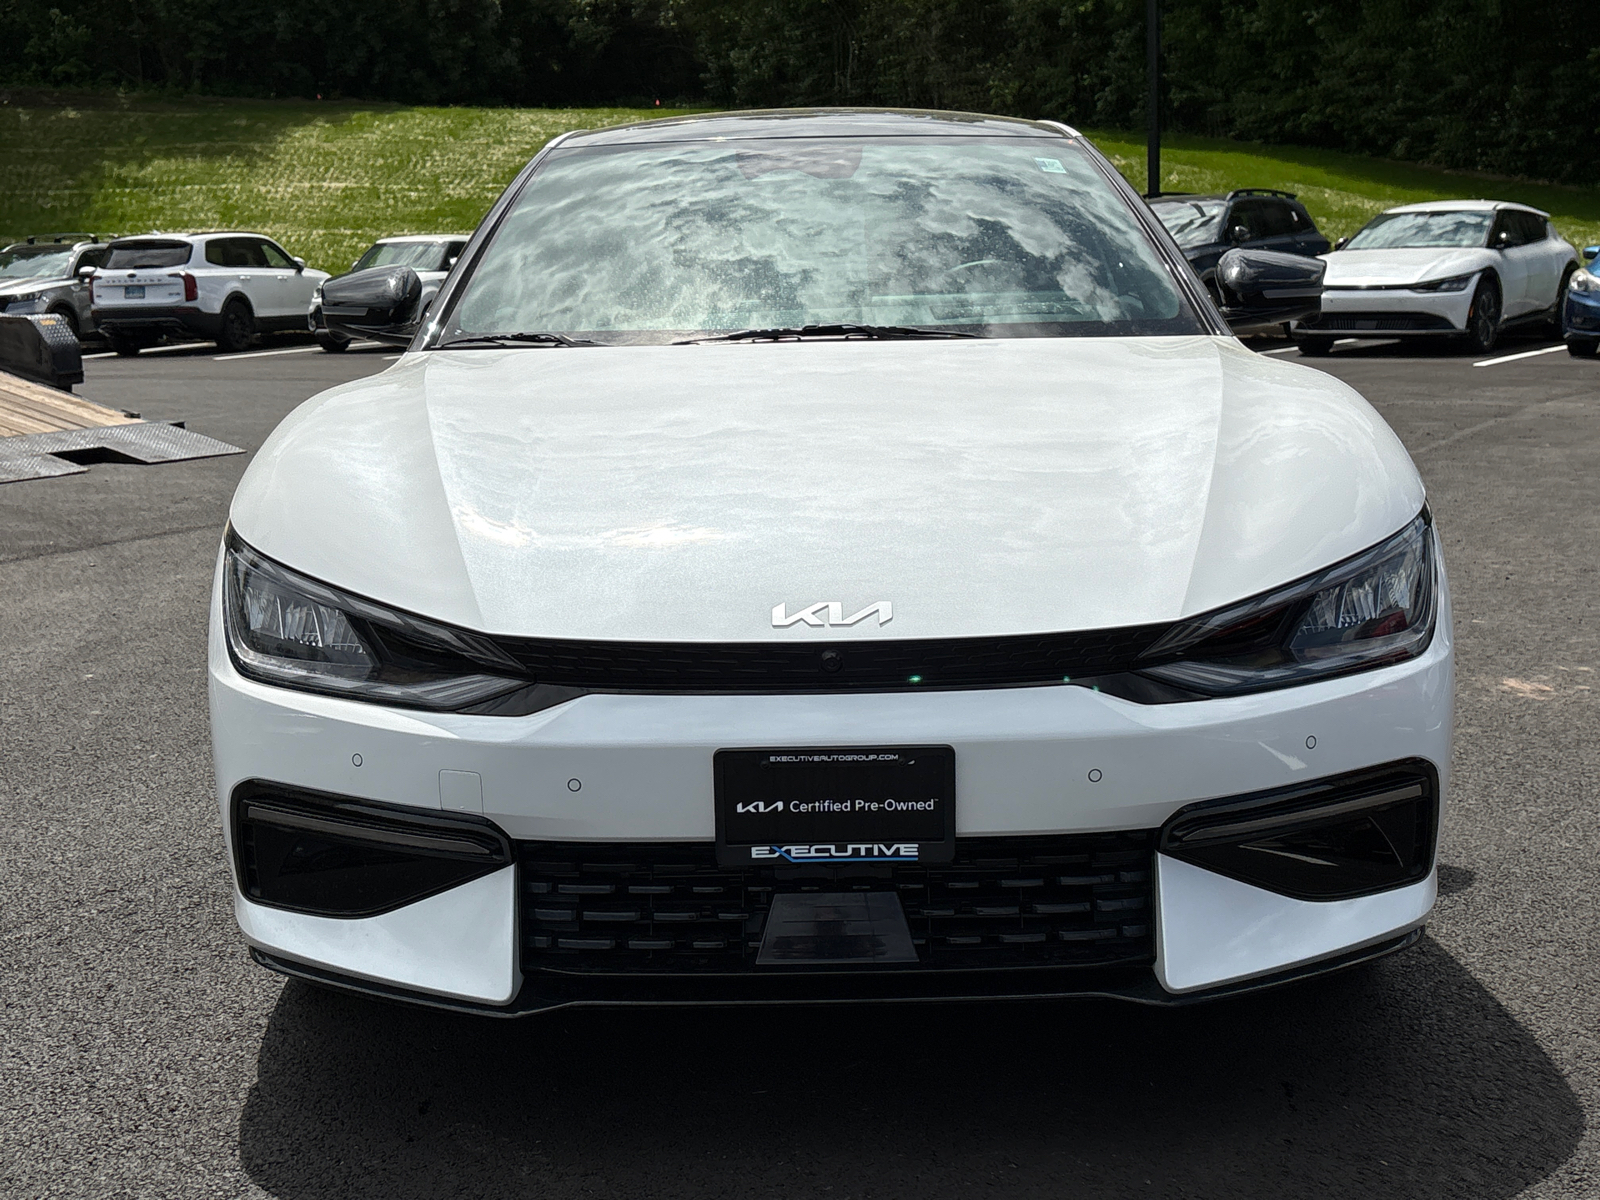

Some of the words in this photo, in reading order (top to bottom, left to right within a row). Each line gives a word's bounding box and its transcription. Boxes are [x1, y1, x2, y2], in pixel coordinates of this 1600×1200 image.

[771, 600, 894, 629] KIA
[769, 753, 899, 763] EXECUTIVEAUTOGROUP.COM
[736, 801, 784, 813] KIA
[789, 799, 851, 813] Certified
[751, 843, 919, 859] EXECUTIVE
